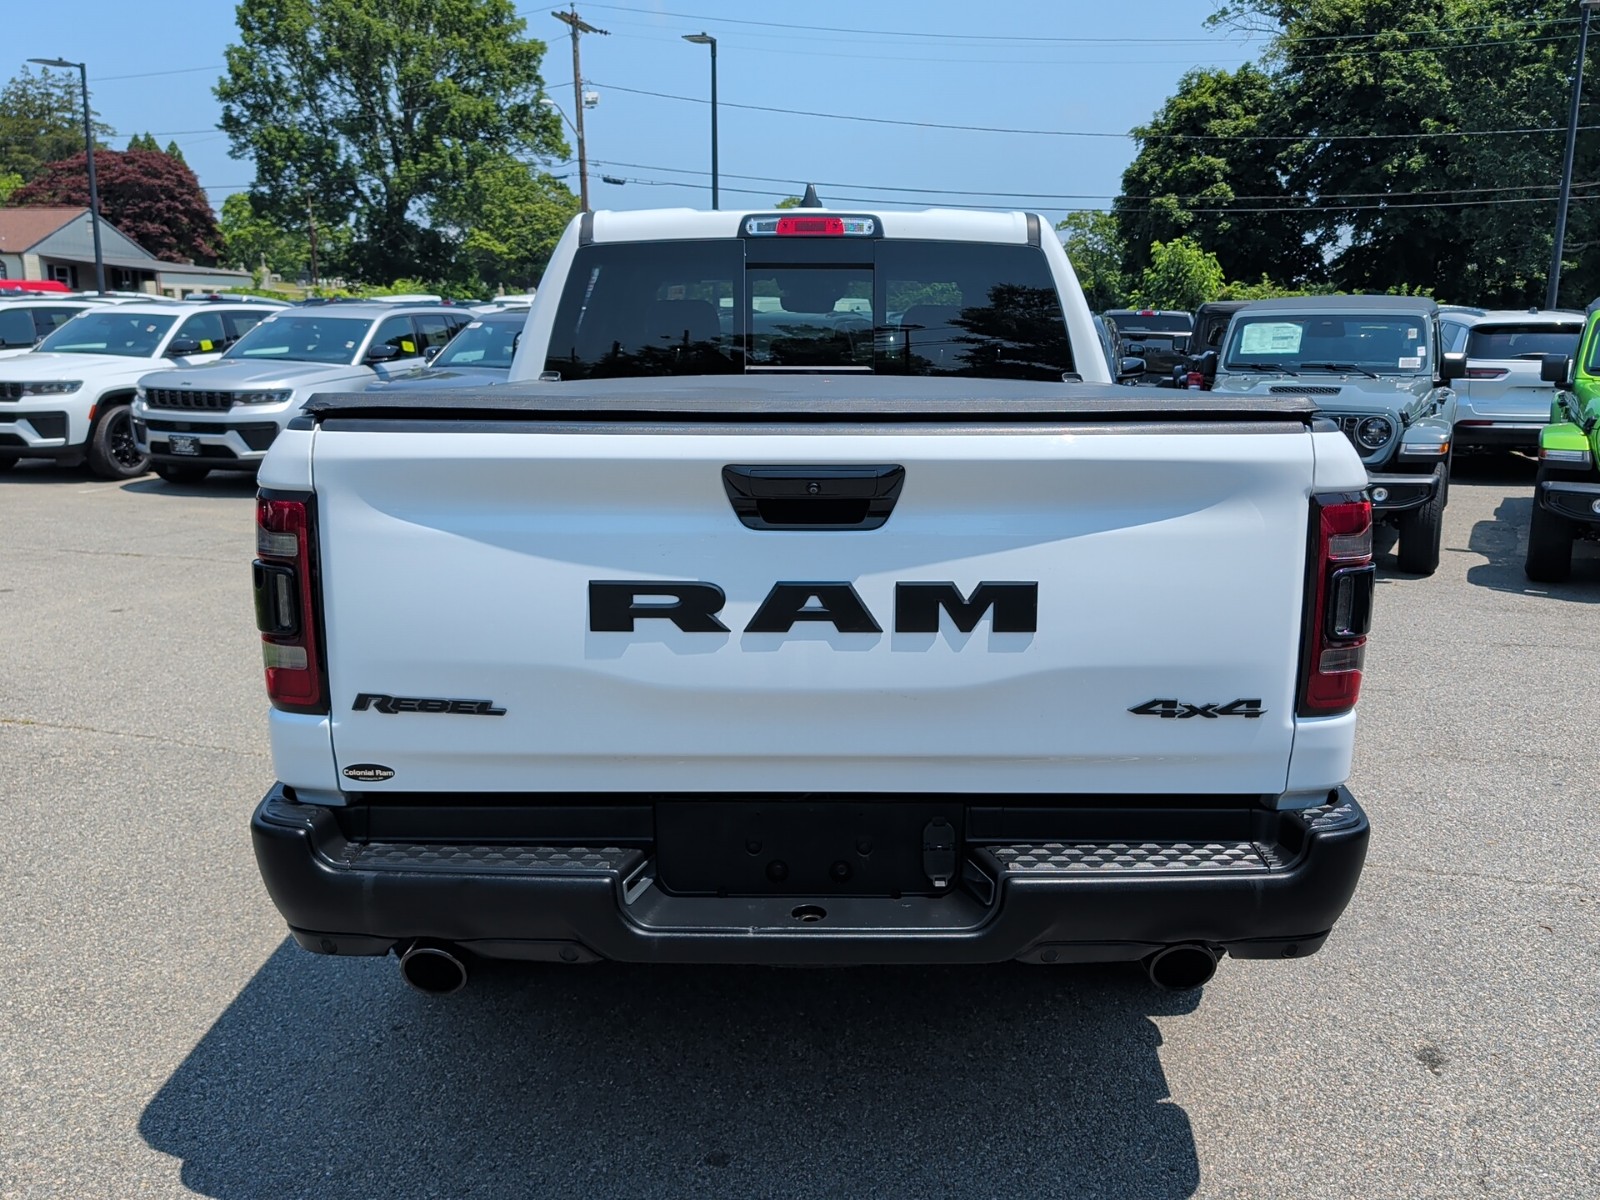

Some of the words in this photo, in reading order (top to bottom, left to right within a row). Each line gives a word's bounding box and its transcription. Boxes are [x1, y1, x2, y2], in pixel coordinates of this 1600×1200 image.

[589, 580, 1038, 632] RAM
[352, 693, 507, 716] REBEL
[1127, 698, 1268, 718] 4x4
